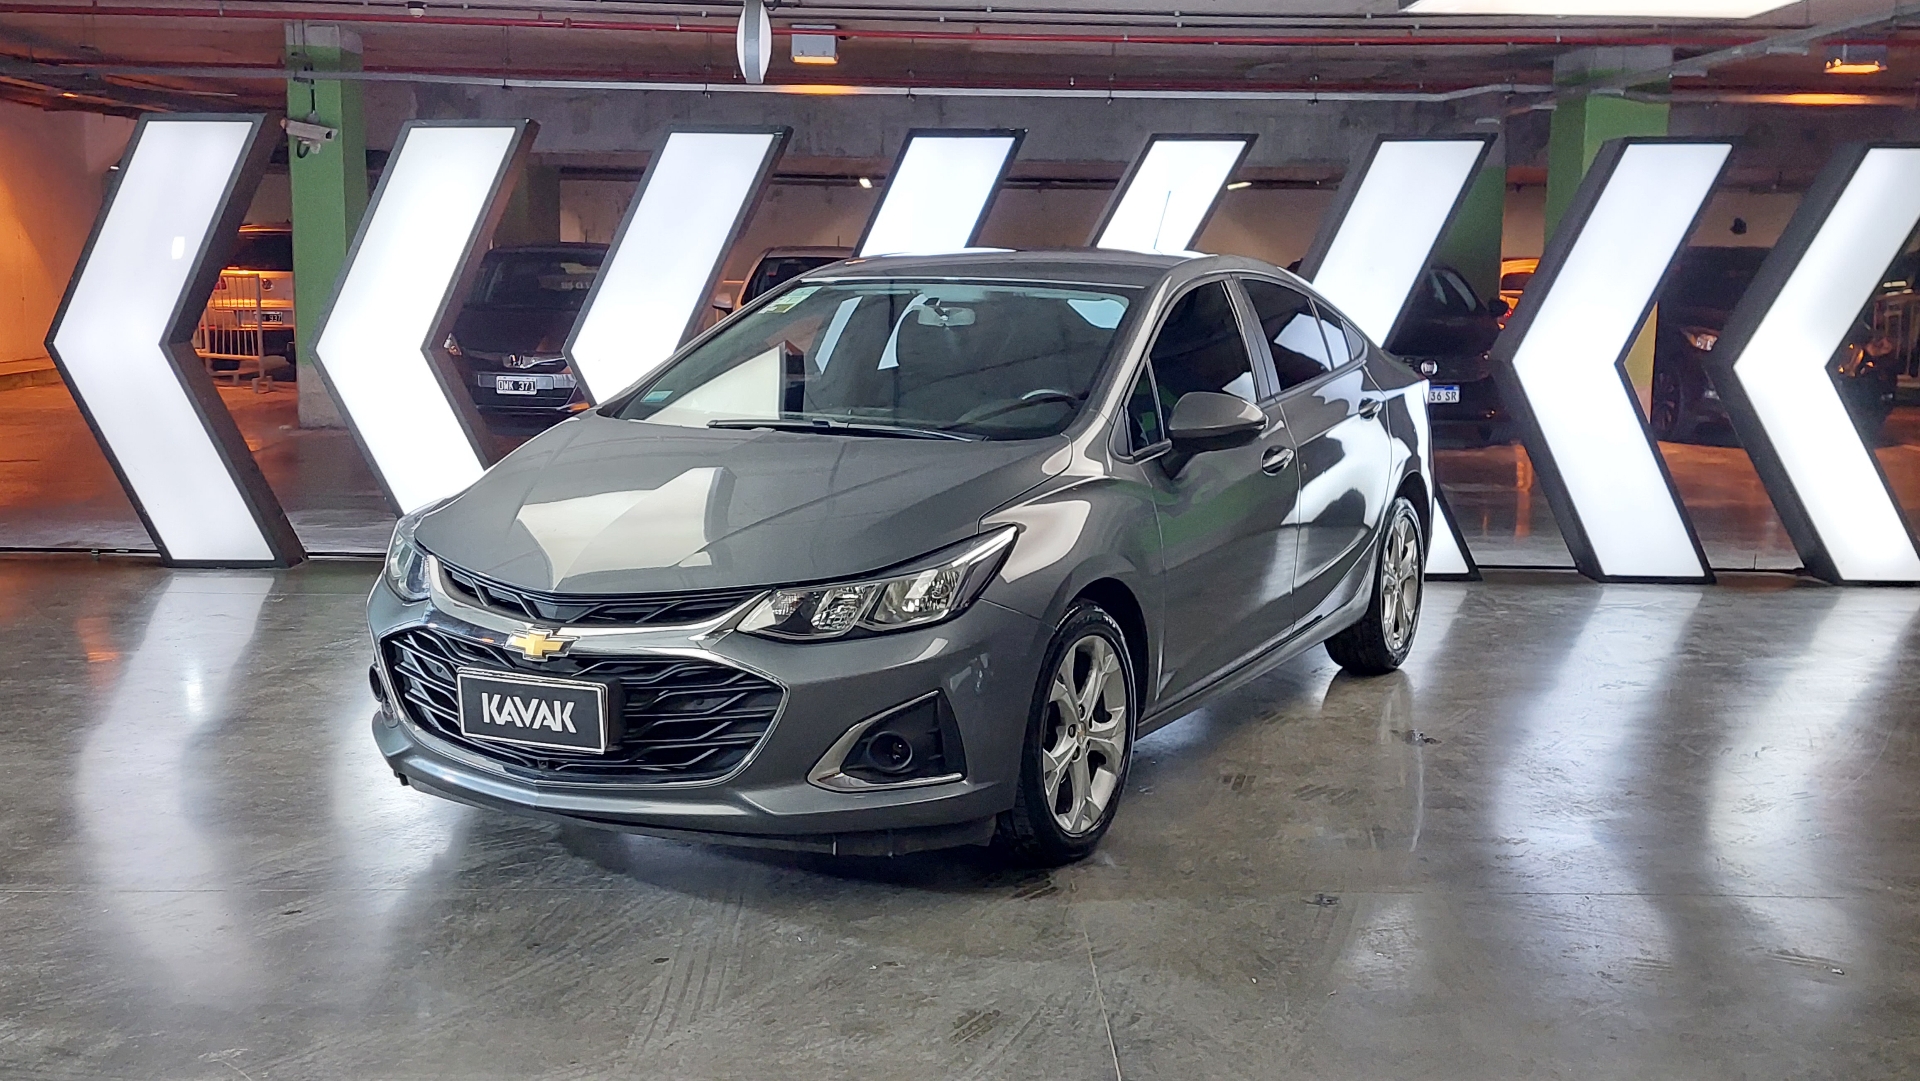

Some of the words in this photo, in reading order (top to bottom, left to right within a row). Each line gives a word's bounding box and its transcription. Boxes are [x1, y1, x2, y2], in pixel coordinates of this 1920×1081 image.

[518, 381, 535, 391] 371
[1430, 391, 1442, 401] 36
[1445, 391, 1457, 401] SR
[481, 692, 577, 734] KAVAK
